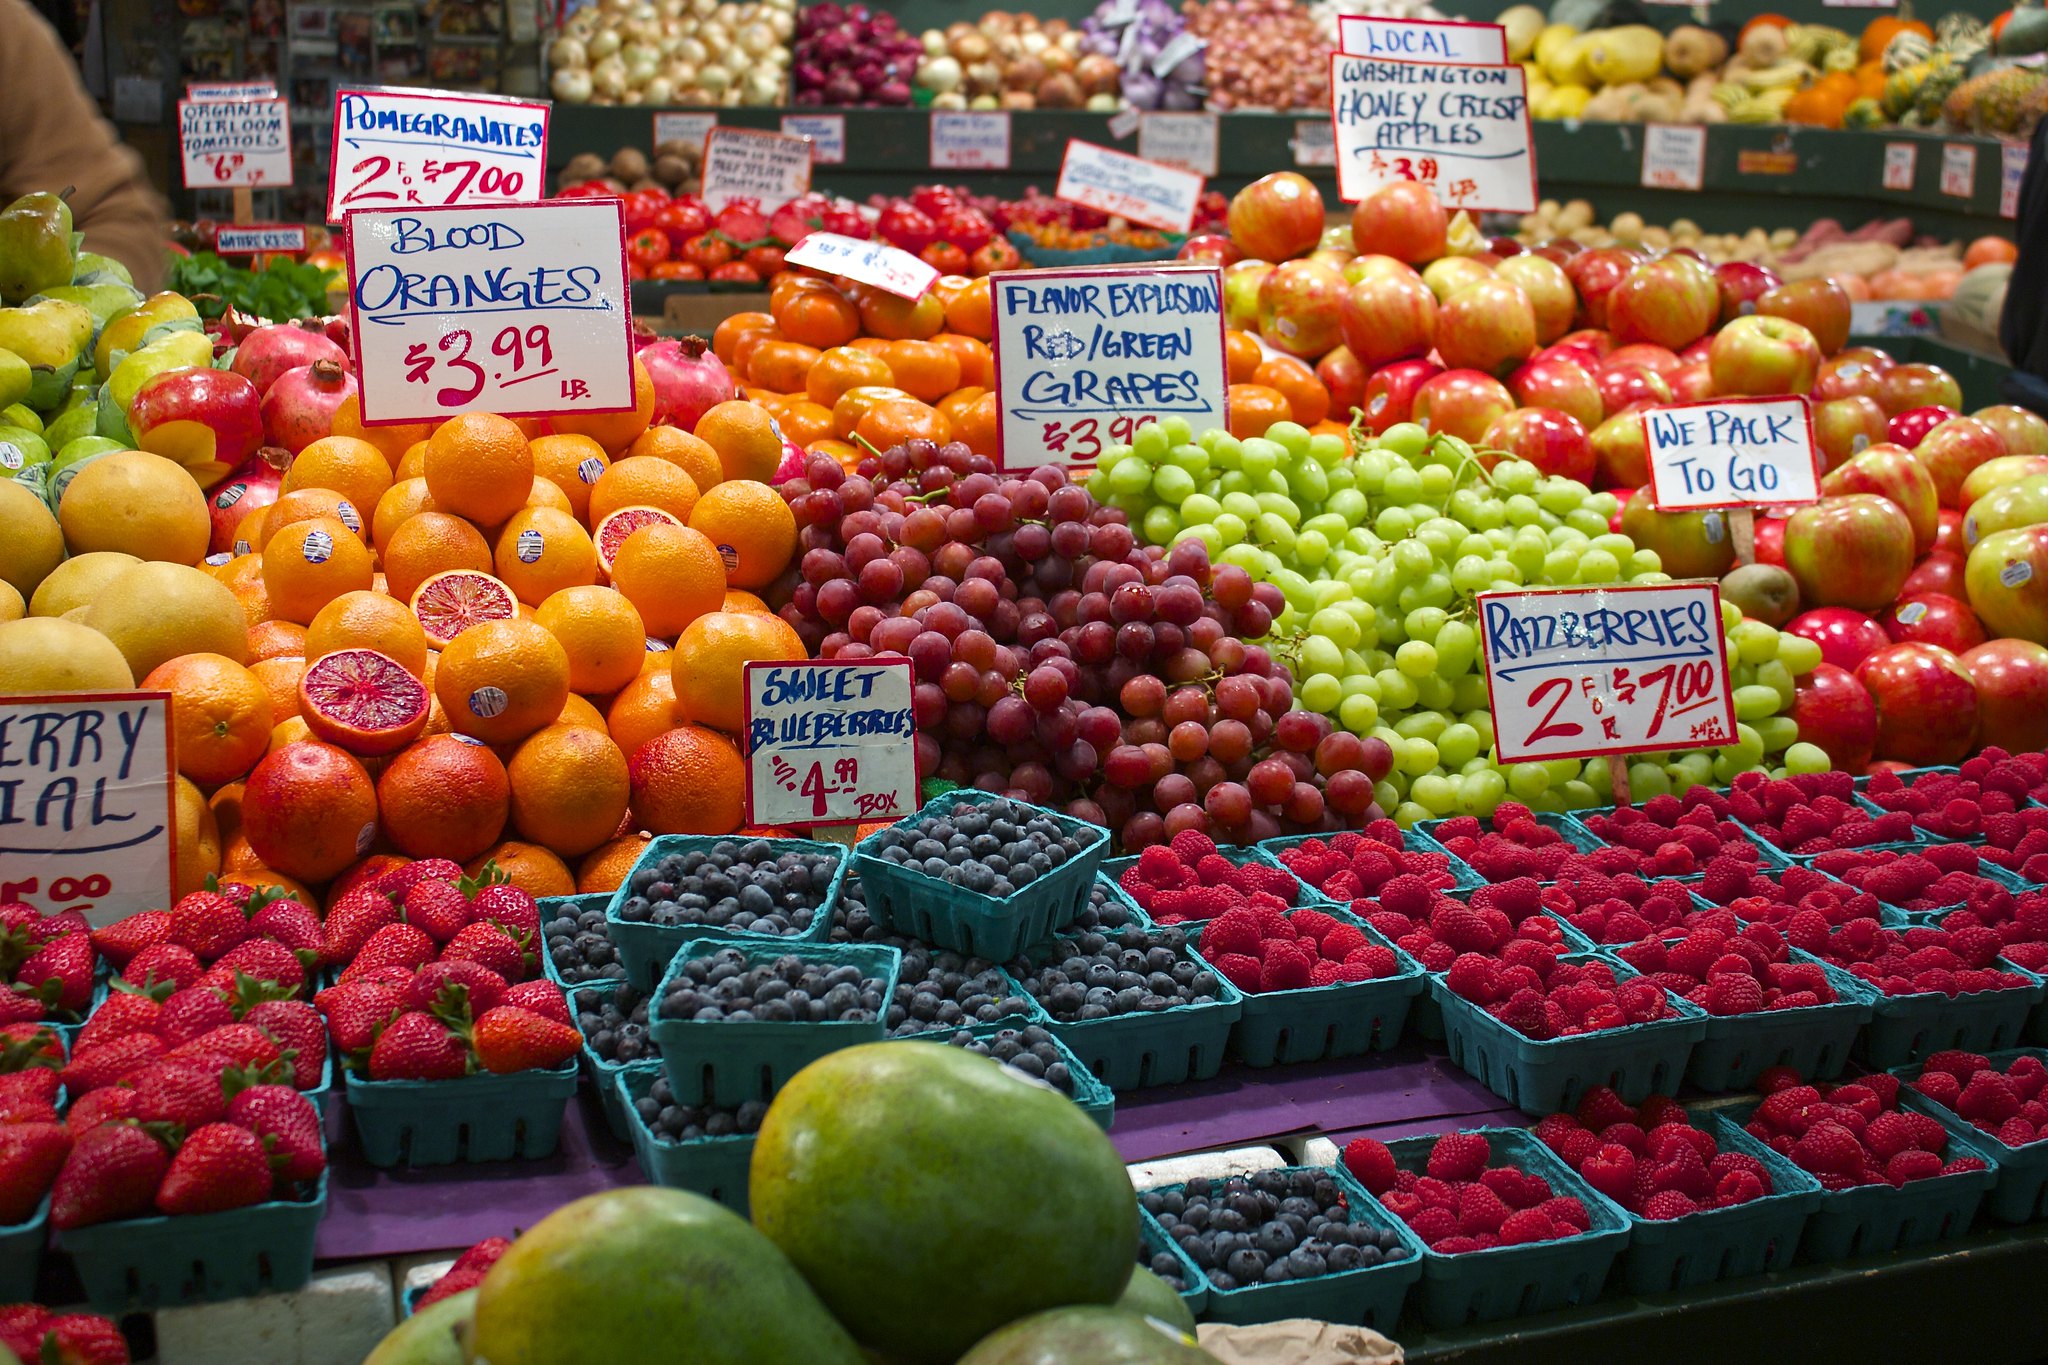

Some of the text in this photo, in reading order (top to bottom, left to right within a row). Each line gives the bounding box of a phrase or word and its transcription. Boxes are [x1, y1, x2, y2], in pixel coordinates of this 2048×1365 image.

[1366, 26, 1461, 58] LOCAL
[1341, 61, 1507, 86] WASHINGTON
[182, 119, 281, 135] HEIRLOOM
[184, 101, 283, 120] ORGANIC
[341, 94, 543, 148] POMEGRANATES
[1338, 88, 1526, 127] HONEY CRISP
[184, 134, 279, 151] TOMATOES
[1376, 122, 1483, 148] APPLES
[339, 155, 399, 205] 2
[390, 217, 525, 255] BLOOD
[355, 264, 601, 312] ORANGES
[1005, 274, 1219, 319] FLAVOR EXPLOSION
[403, 324, 553, 408] $3.99
[1021, 369, 1200, 407] GRAPES
[1652, 409, 1799, 449] WE PACK
[1727, 454, 1779, 492] GO
[1486, 600, 1711, 664] RAZZBERRIES
[761, 668, 886, 706] SWEET
[746, 708, 918, 754] BLUEBERRIES
[1523, 677, 1584, 747] 2
[772, 755, 898, 817] $4.99 BOX
